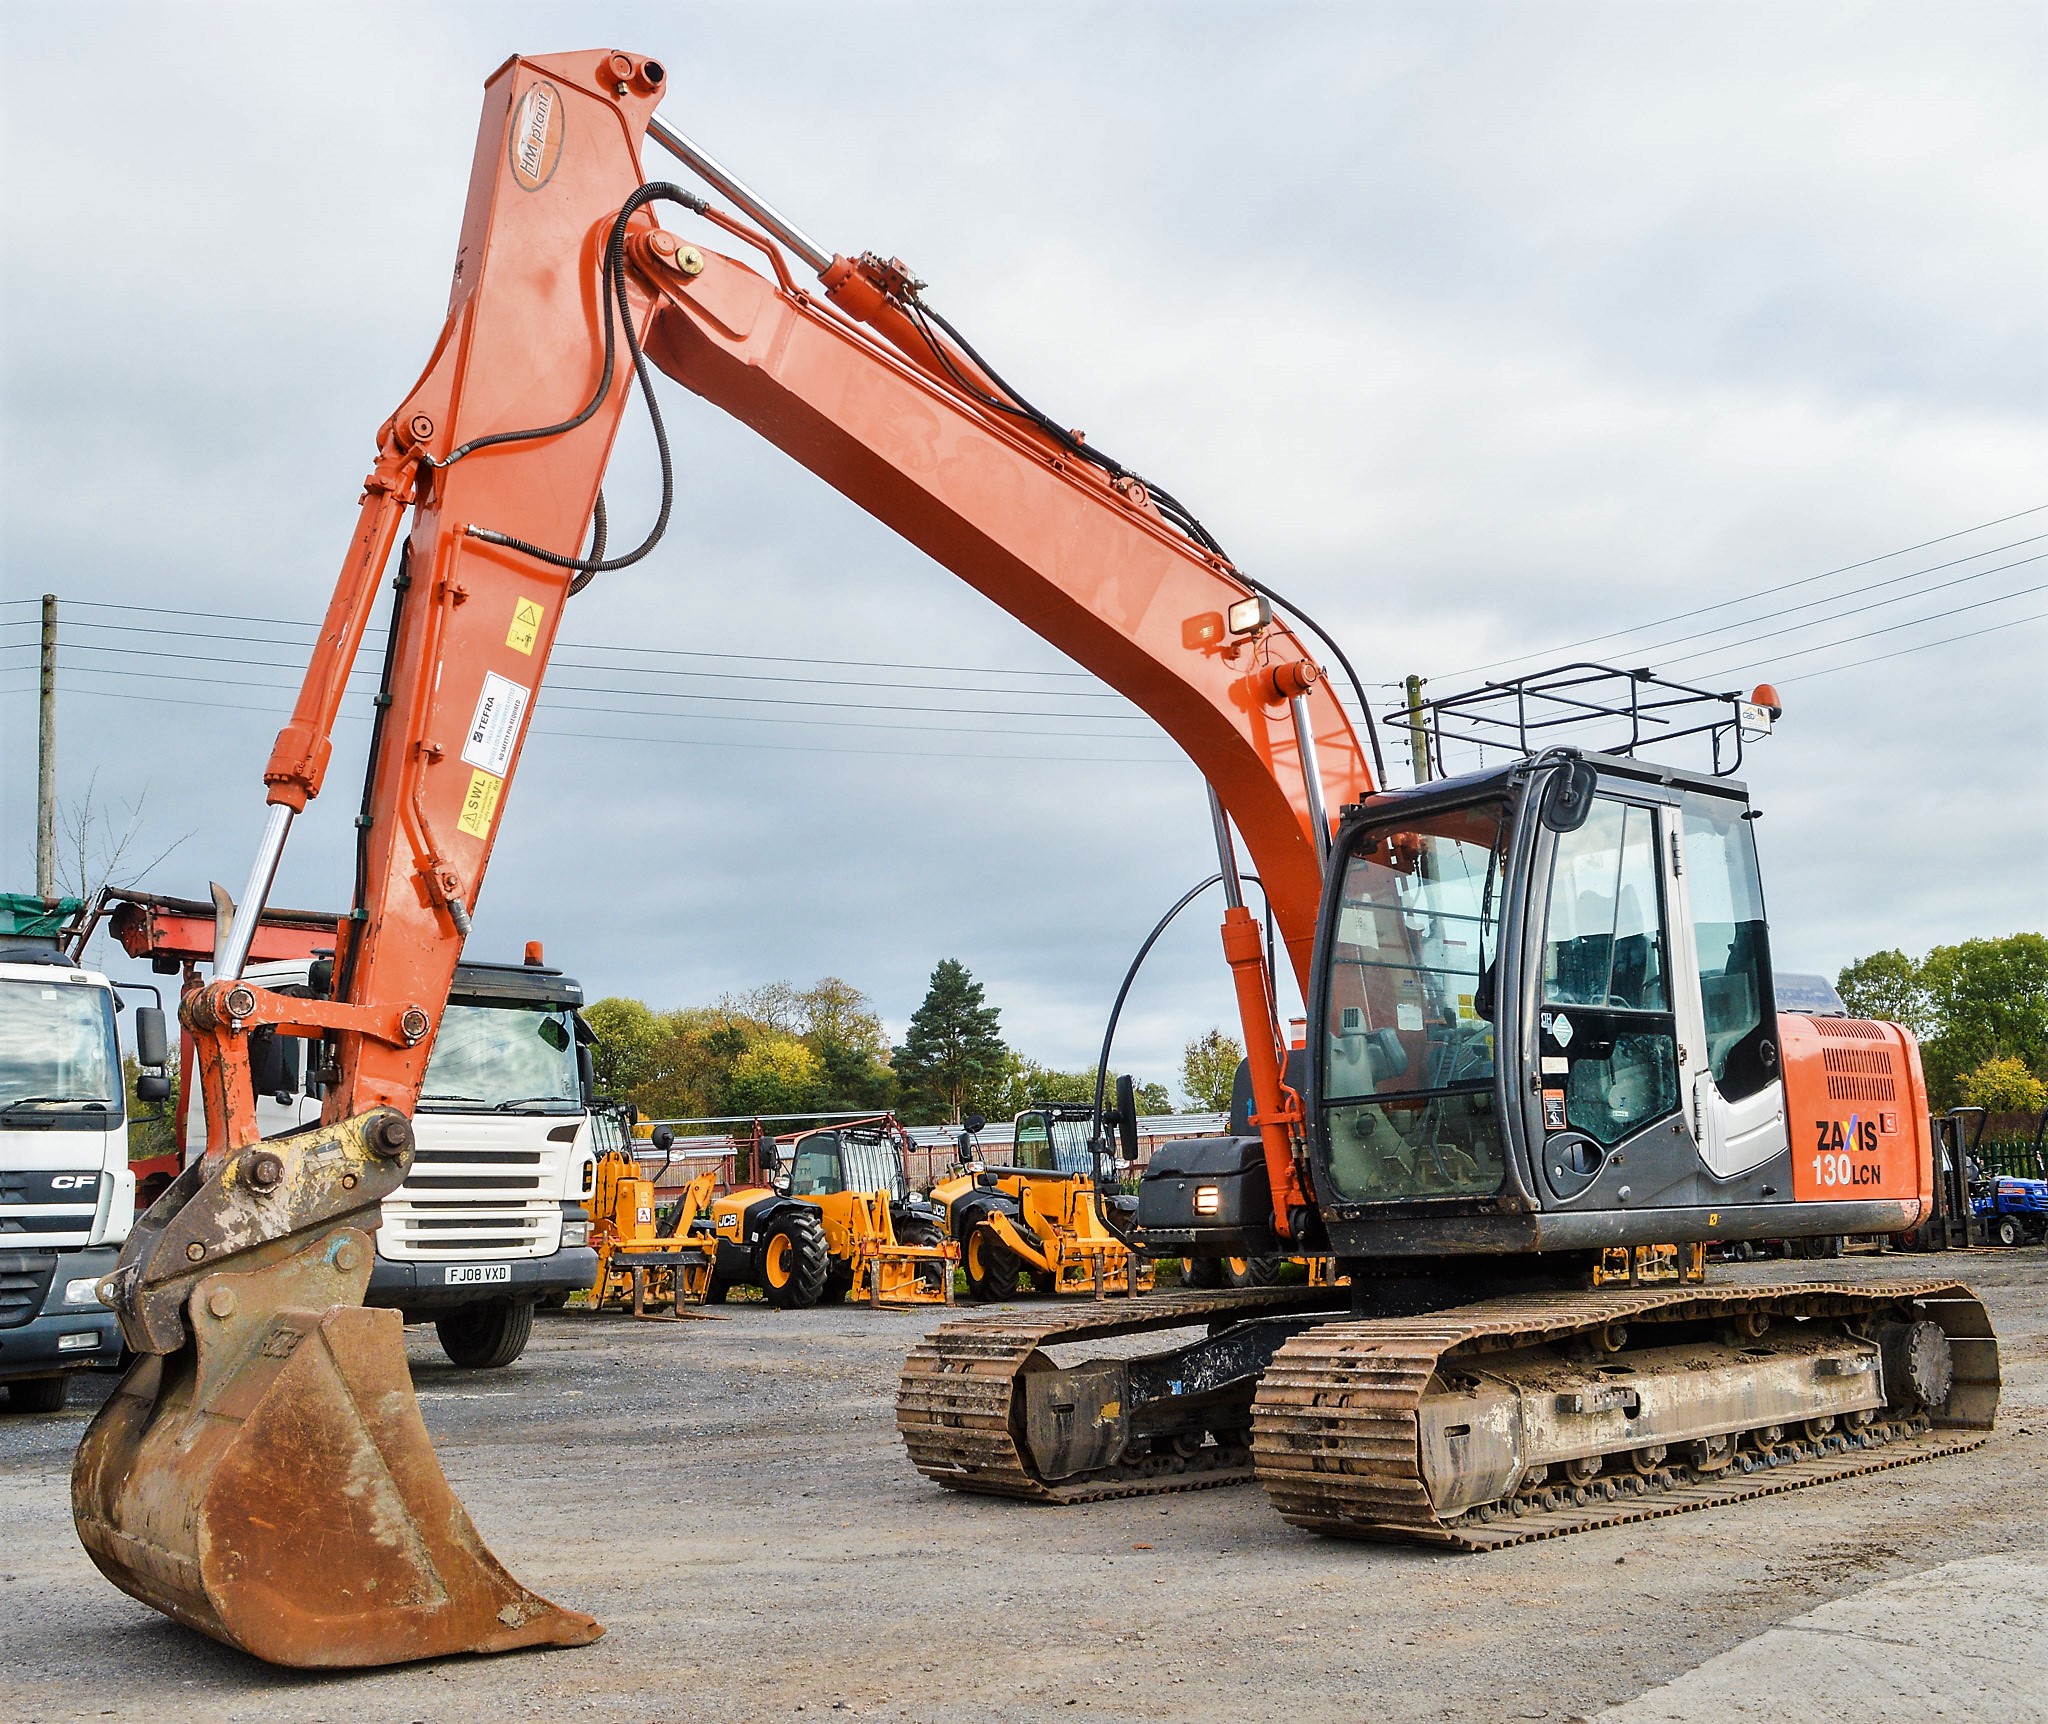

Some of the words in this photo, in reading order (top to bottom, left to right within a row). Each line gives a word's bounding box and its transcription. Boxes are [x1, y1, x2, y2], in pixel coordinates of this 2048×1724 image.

[478, 696, 494, 731] TEFRA
[501, 734, 510, 753] SAFETY
[509, 700, 521, 725] REQUIRED
[468, 777, 485, 810] SWL
[1816, 1114, 1877, 1151] ZAXIS
[51, 1176, 96, 1189] CF
[719, 1215, 736, 1226] JCB
[450, 1269, 481, 1282] FJ08
[485, 1267, 506, 1280] VXD
